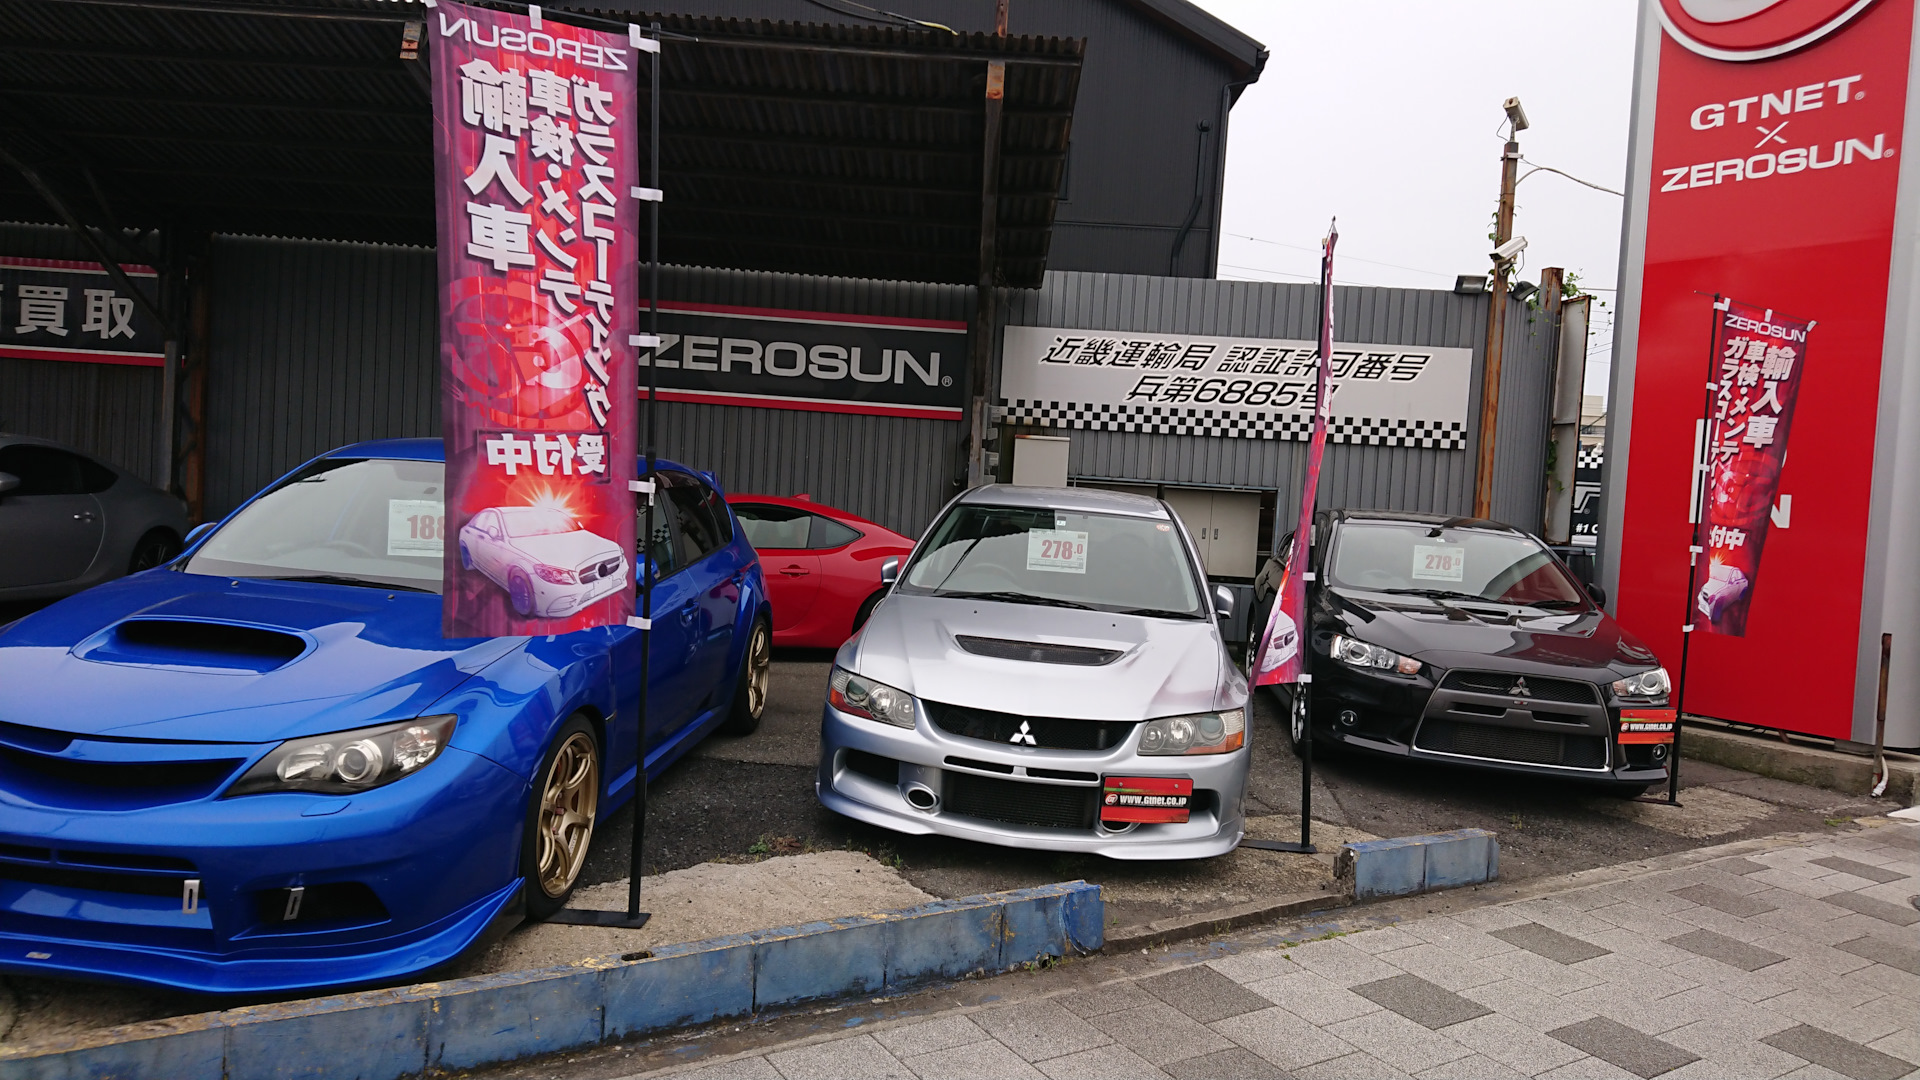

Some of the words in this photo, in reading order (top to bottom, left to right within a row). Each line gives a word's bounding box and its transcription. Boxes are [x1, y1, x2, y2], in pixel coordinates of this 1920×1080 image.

[0, 283, 136, 340] 買取
[1724, 313, 1807, 343] ZEROSUN
[1042, 336, 1216, 373] 近畿運輸局
[1719, 339, 1769, 463] 車検・メンテ
[1742, 345, 1798, 449] 輸入車
[1709, 525, 1747, 551] 付中
